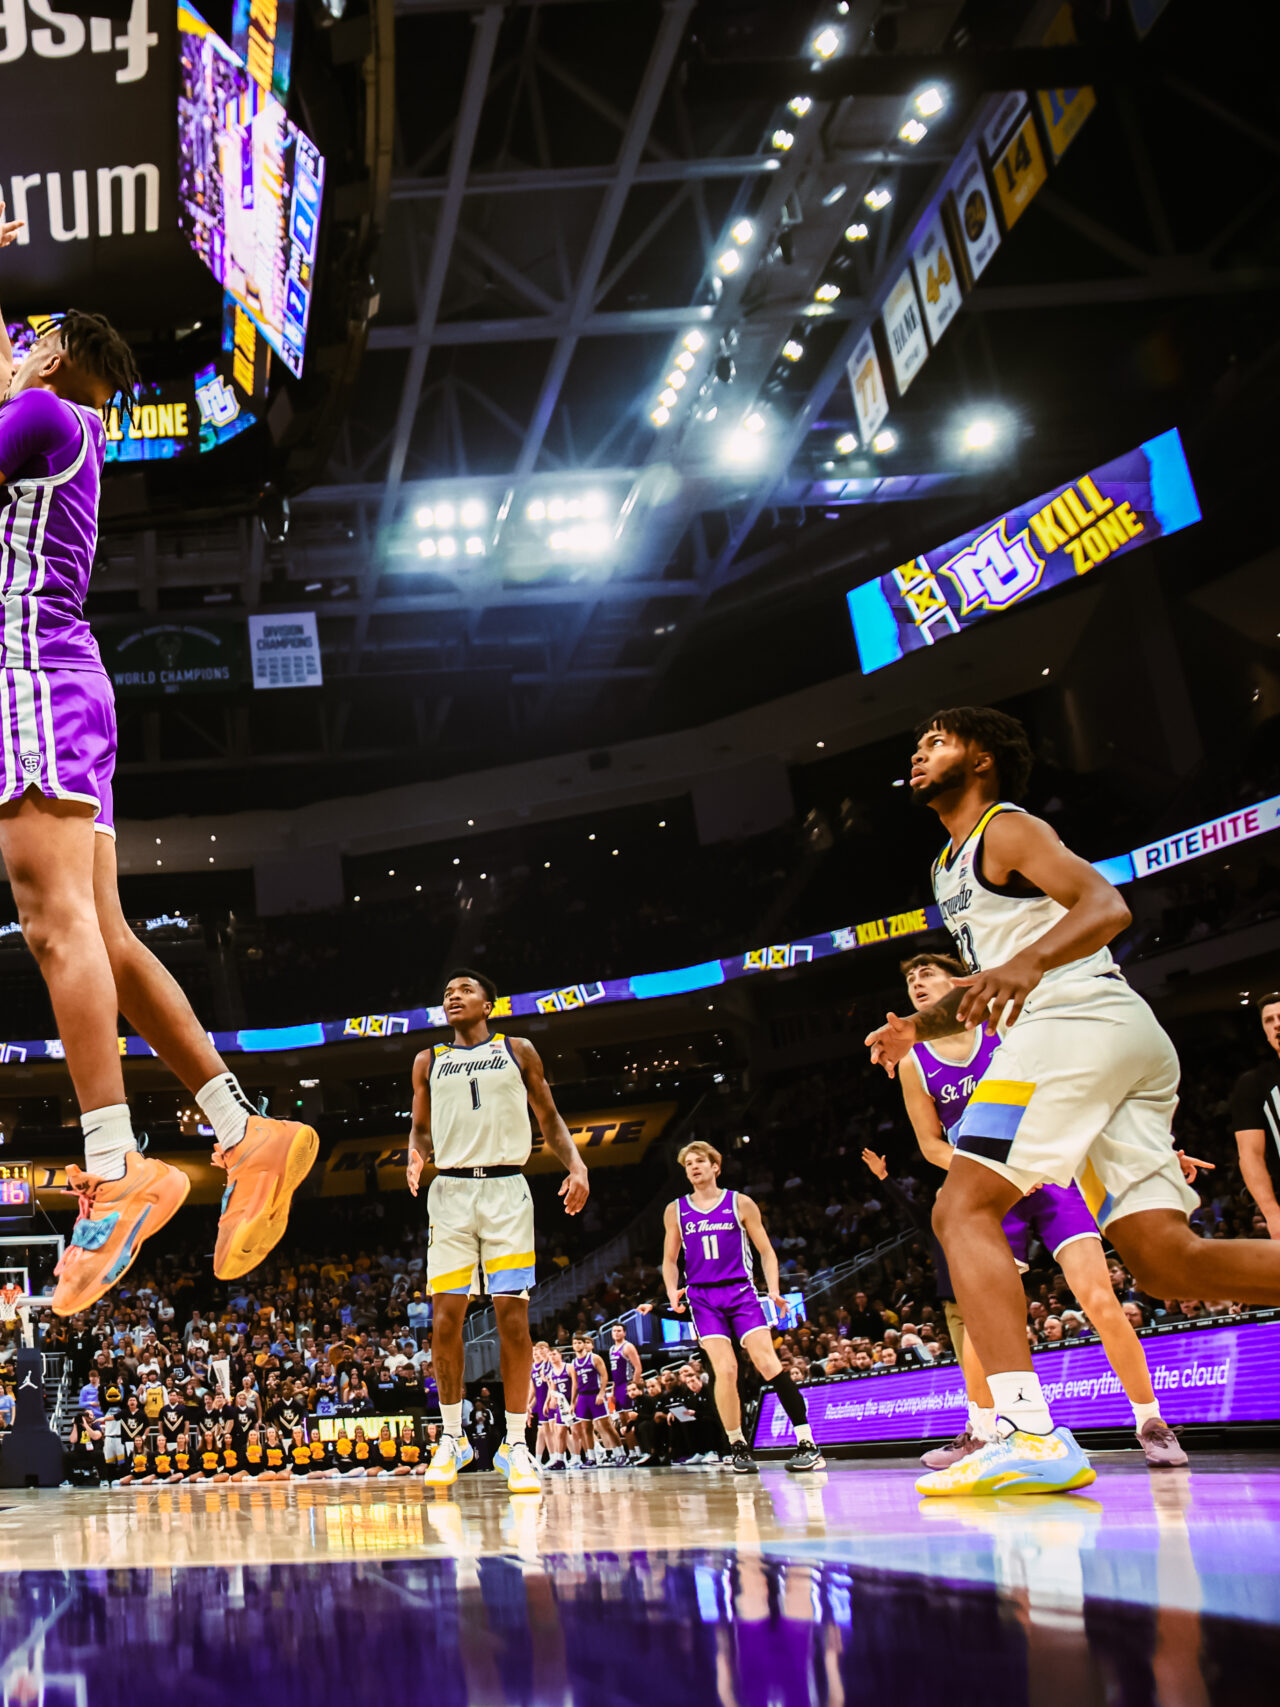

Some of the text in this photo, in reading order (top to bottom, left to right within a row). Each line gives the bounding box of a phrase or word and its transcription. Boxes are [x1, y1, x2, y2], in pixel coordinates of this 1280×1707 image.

[1028, 475, 1113, 554] KILL
[1063, 500, 1145, 576] ZONE
[942, 522, 1040, 612] MU
[114, 666, 230, 686] WORLD CHAMPIONS
[1145, 808, 1260, 870] RITEHITE
[855, 919, 889, 946] KILL
[887, 908, 929, 938] ZONE
[437, 1056, 508, 1080] Marquette
[469, 1077, 481, 1110] 1
[2, 1180, 25, 1204] 16
[697, 1219, 735, 1233] Thomas
[701, 1234, 720, 1260] 11
[1064, 1367, 1126, 1401] everythin
[1154, 1364, 1179, 1390] the
[1181, 1357, 1231, 1387] cloud
[824, 1402, 865, 1421] Redefining
[865, 1400, 879, 1416] the
[895, 1394, 943, 1416] companies
